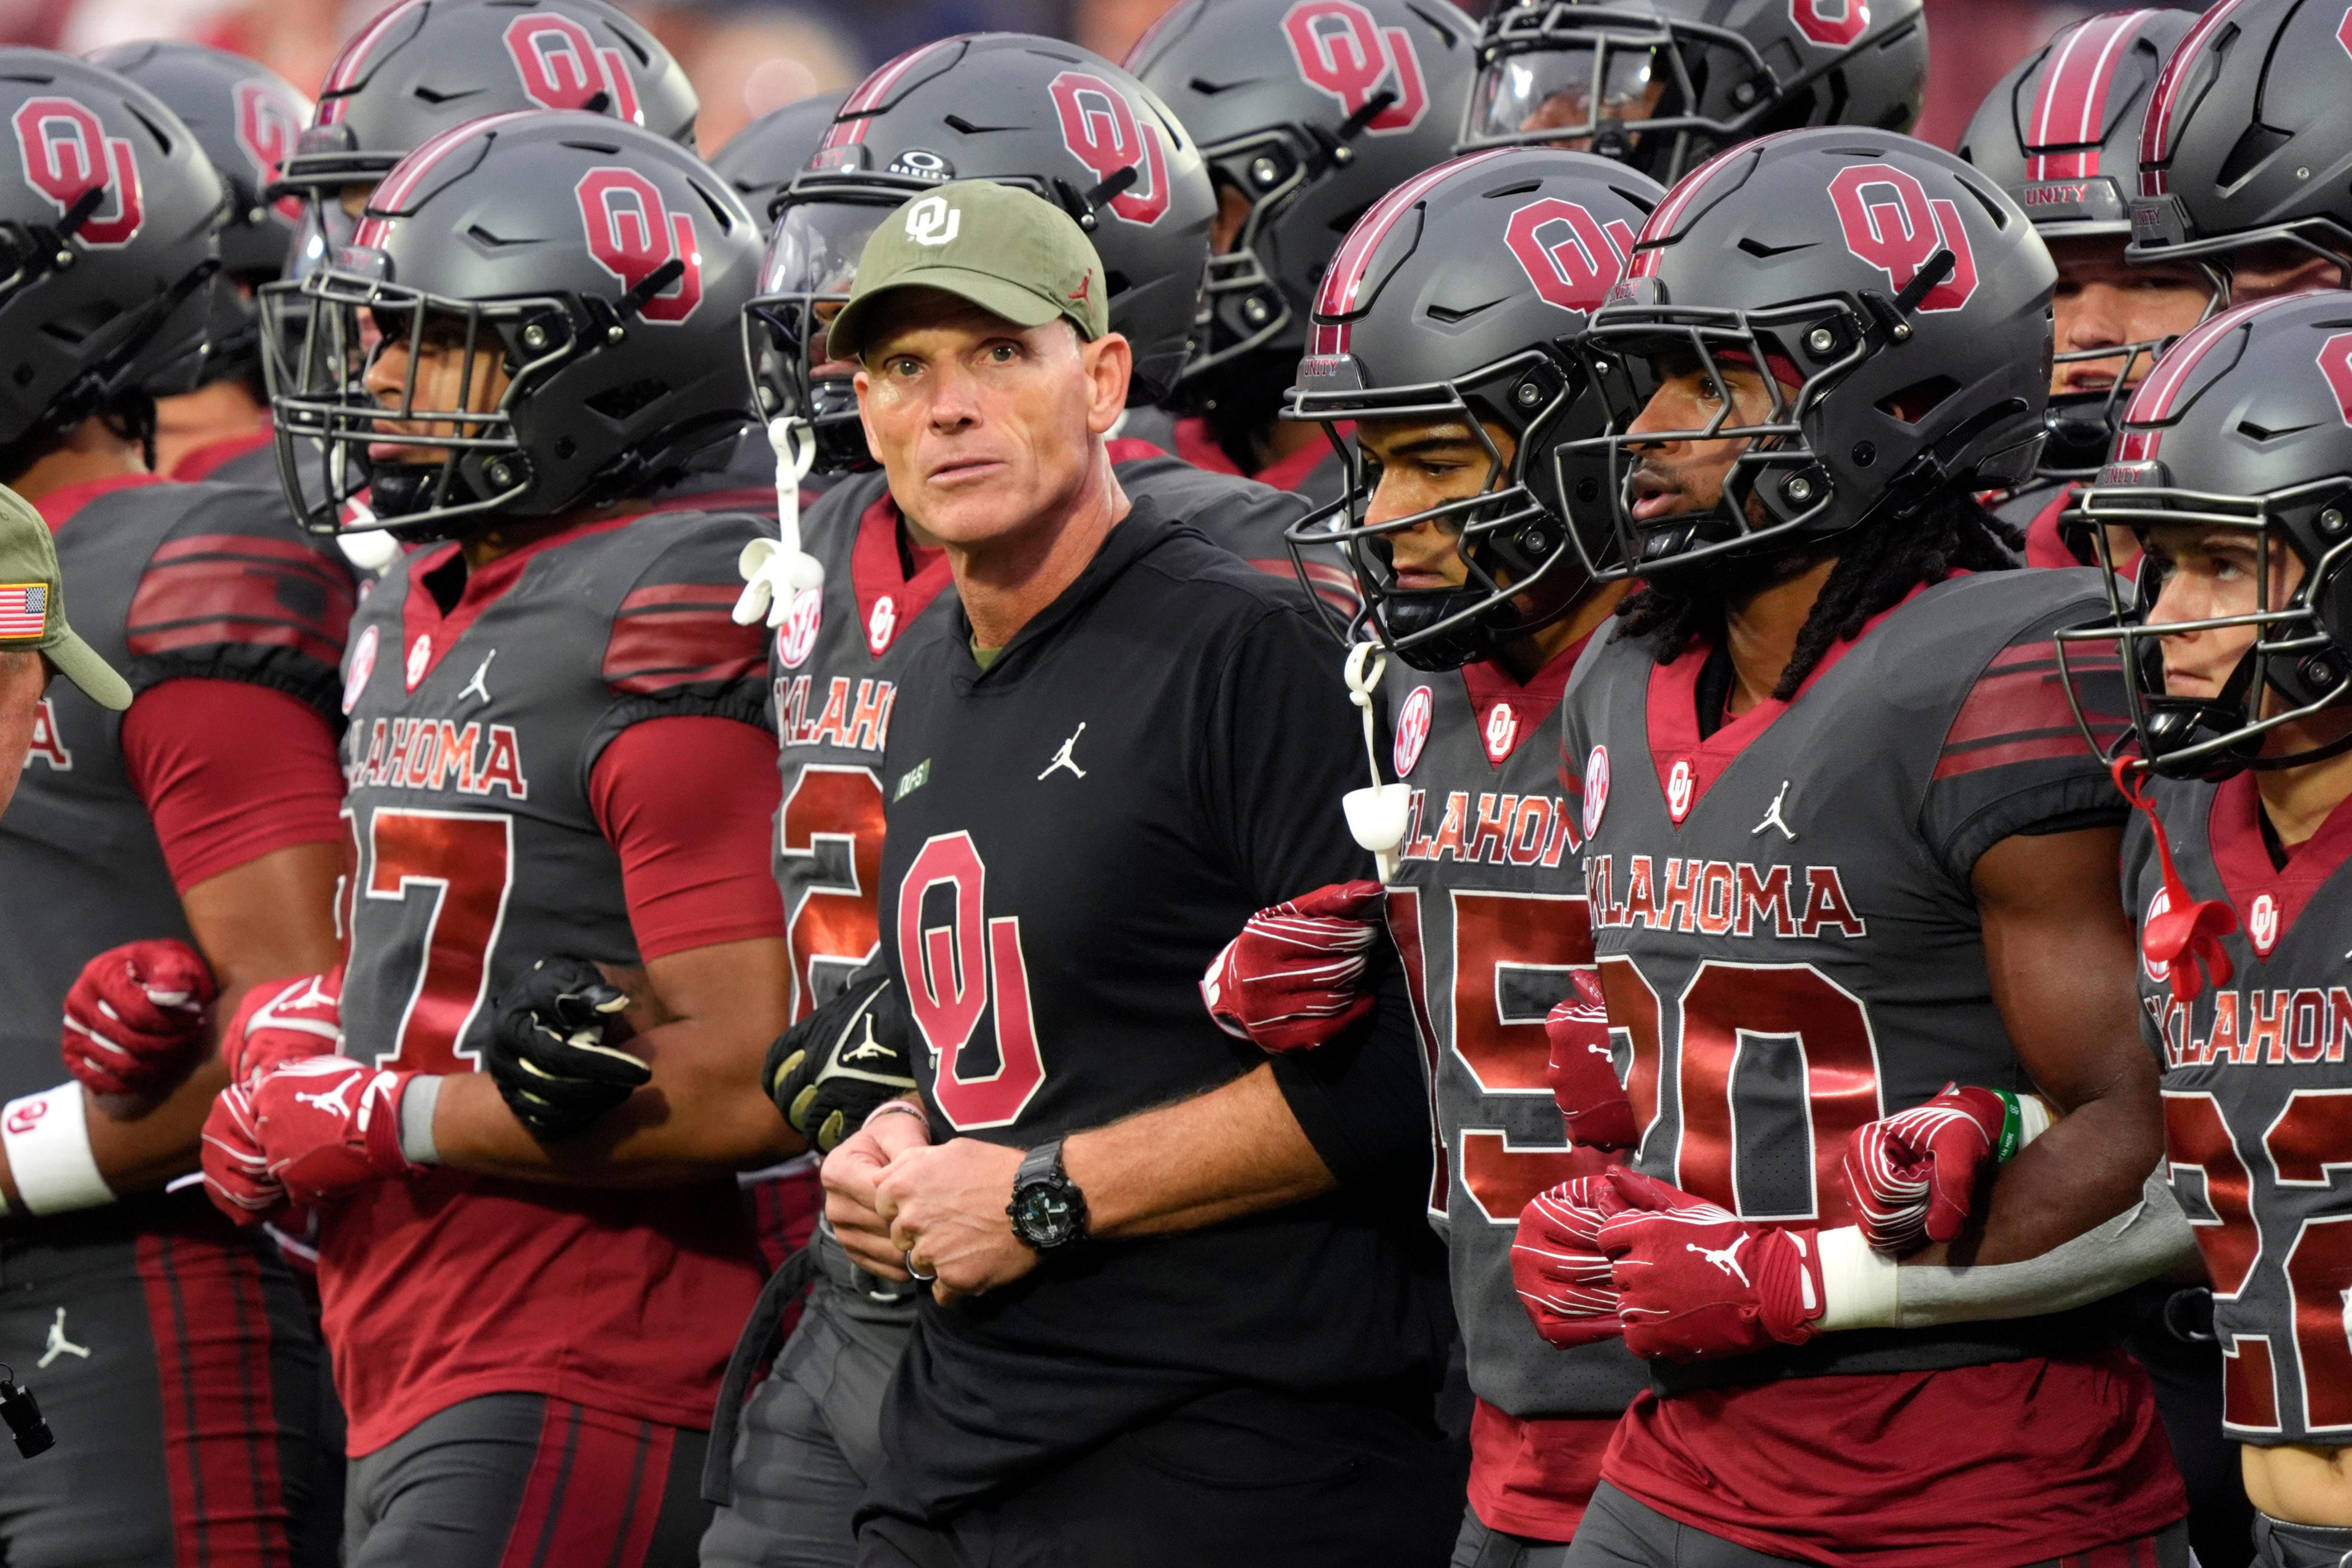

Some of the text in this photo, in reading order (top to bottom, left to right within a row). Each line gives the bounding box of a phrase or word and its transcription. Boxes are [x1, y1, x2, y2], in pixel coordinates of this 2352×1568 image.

[1281, 0, 1429, 136] OU
[11, 96, 144, 249] OU
[1047, 71, 1172, 227] OU
[905, 196, 960, 245] OU
[2025, 184, 2088, 206] UNITY
[575, 167, 703, 326] OU
[1826, 164, 1979, 314] OU
[1305, 358, 1339, 376] UNITY
[869, 596, 896, 649] OU
[1486, 703, 1517, 755] OU
[1668, 761, 1693, 816] OU
[2251, 894, 2279, 950] OU
[898, 829, 1046, 1131] OU
